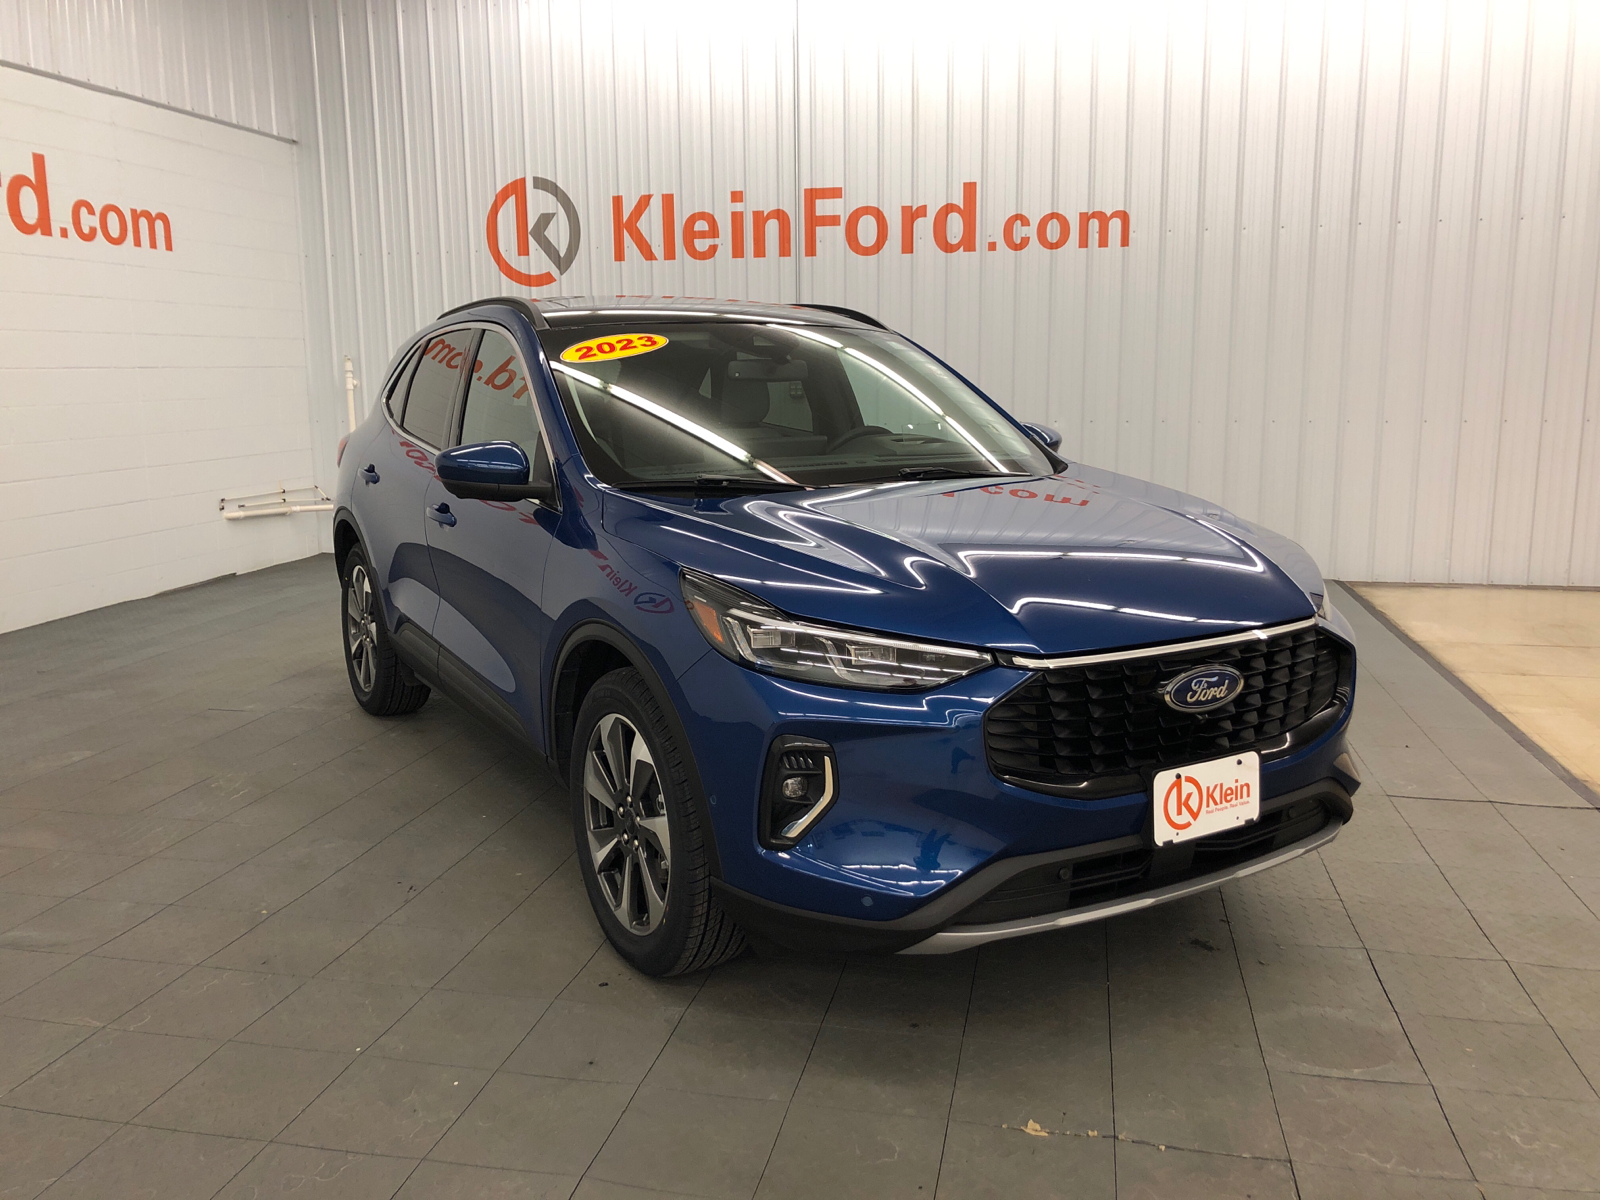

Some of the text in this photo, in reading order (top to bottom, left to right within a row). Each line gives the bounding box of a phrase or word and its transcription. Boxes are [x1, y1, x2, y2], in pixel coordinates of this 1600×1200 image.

[0, 151, 174, 252] d.com
[611, 181, 1131, 263] KleinFord.com
[574, 335, 659, 361] 2023
[1186, 676, 1229, 703] Ford
[1205, 778, 1251, 809] Klein
